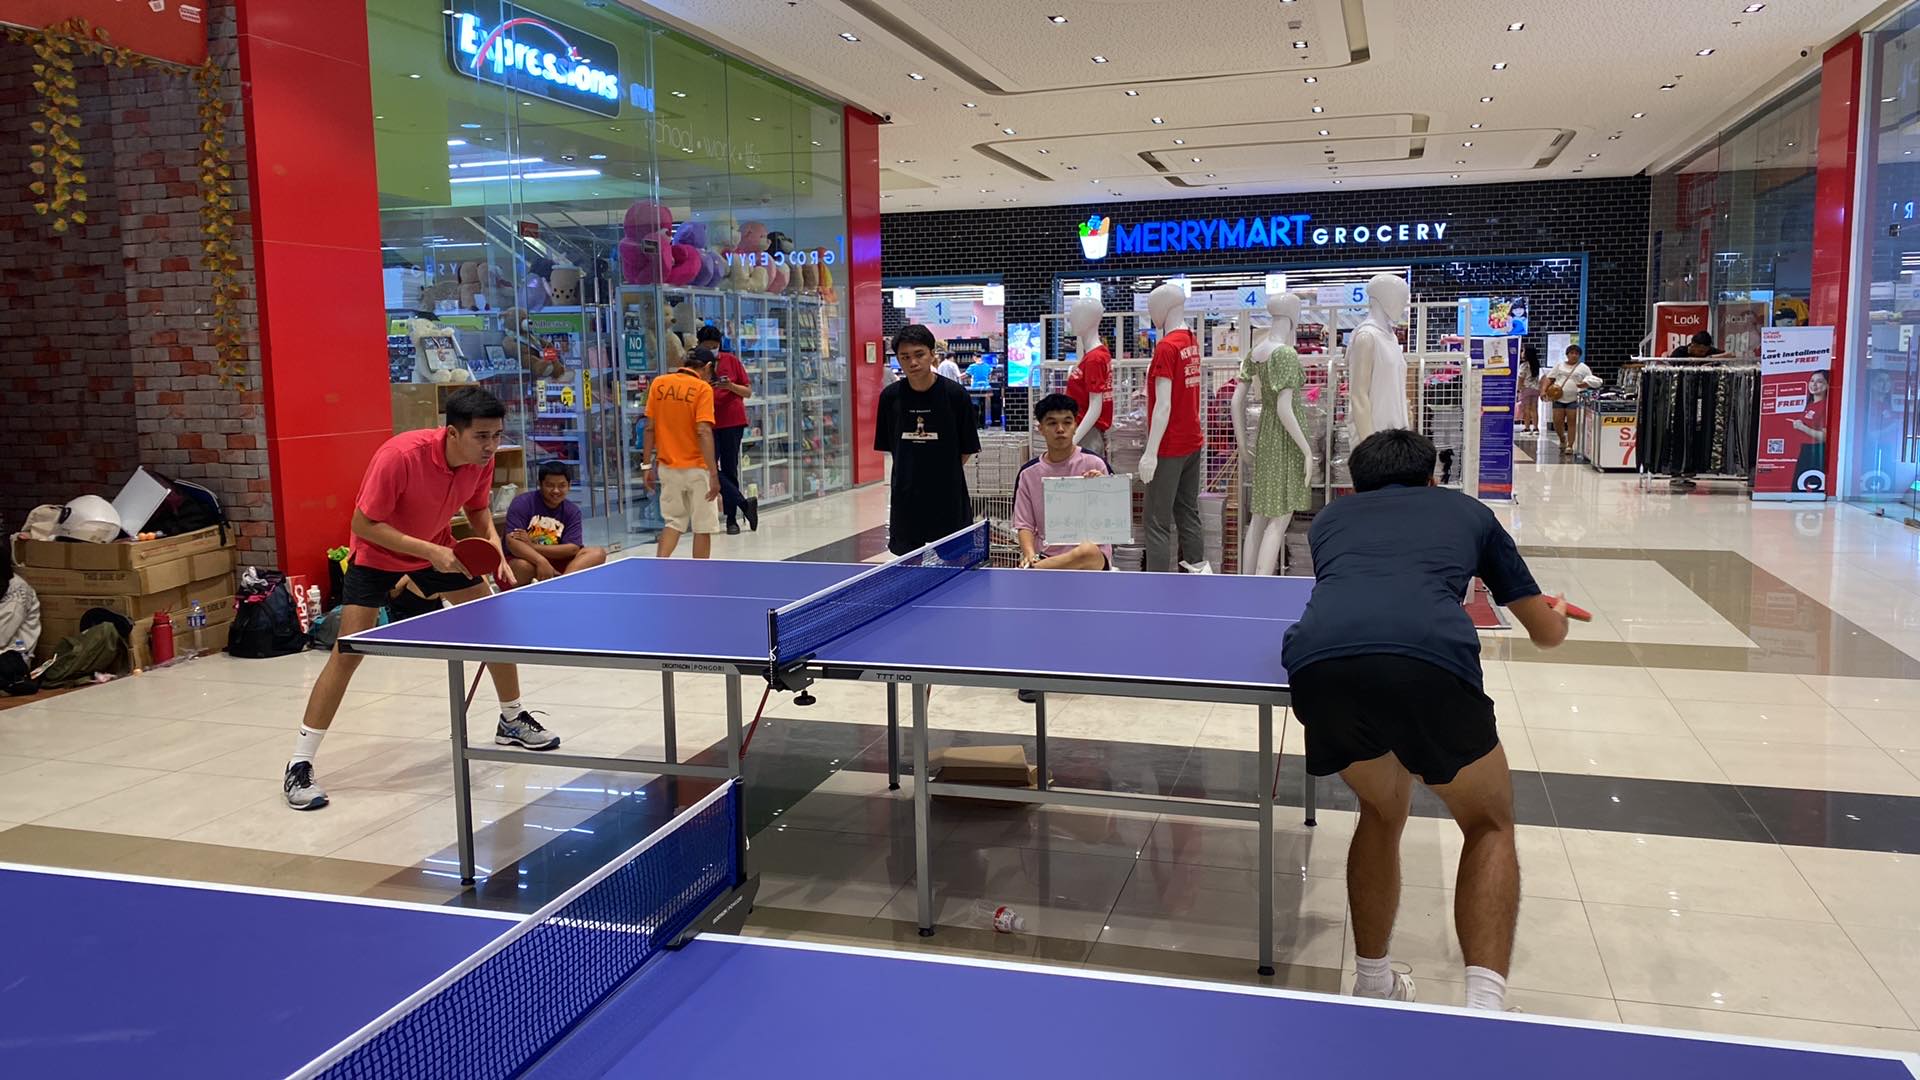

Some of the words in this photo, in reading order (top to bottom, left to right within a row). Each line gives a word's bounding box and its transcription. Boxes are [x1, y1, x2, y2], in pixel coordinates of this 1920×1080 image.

[460, 12, 618, 100] Expressions
[1114, 214, 1312, 254] MERRYMART
[1312, 222, 1447, 245] GROCERY
[1245, 291, 1257, 306] 4
[1352, 287, 1364, 303] 5
[935, 302, 943, 316] 1
[1674, 314, 1701, 325] Look
[630, 337, 642, 350] NO
[1667, 332, 1694, 353] BI
[1762, 352, 1781, 360] Last
[1782, 348, 1830, 358] Installment
[656, 384, 697, 404] SALE
[1777, 399, 1804, 408] FREE!
[876, 672, 894, 680] TTT
